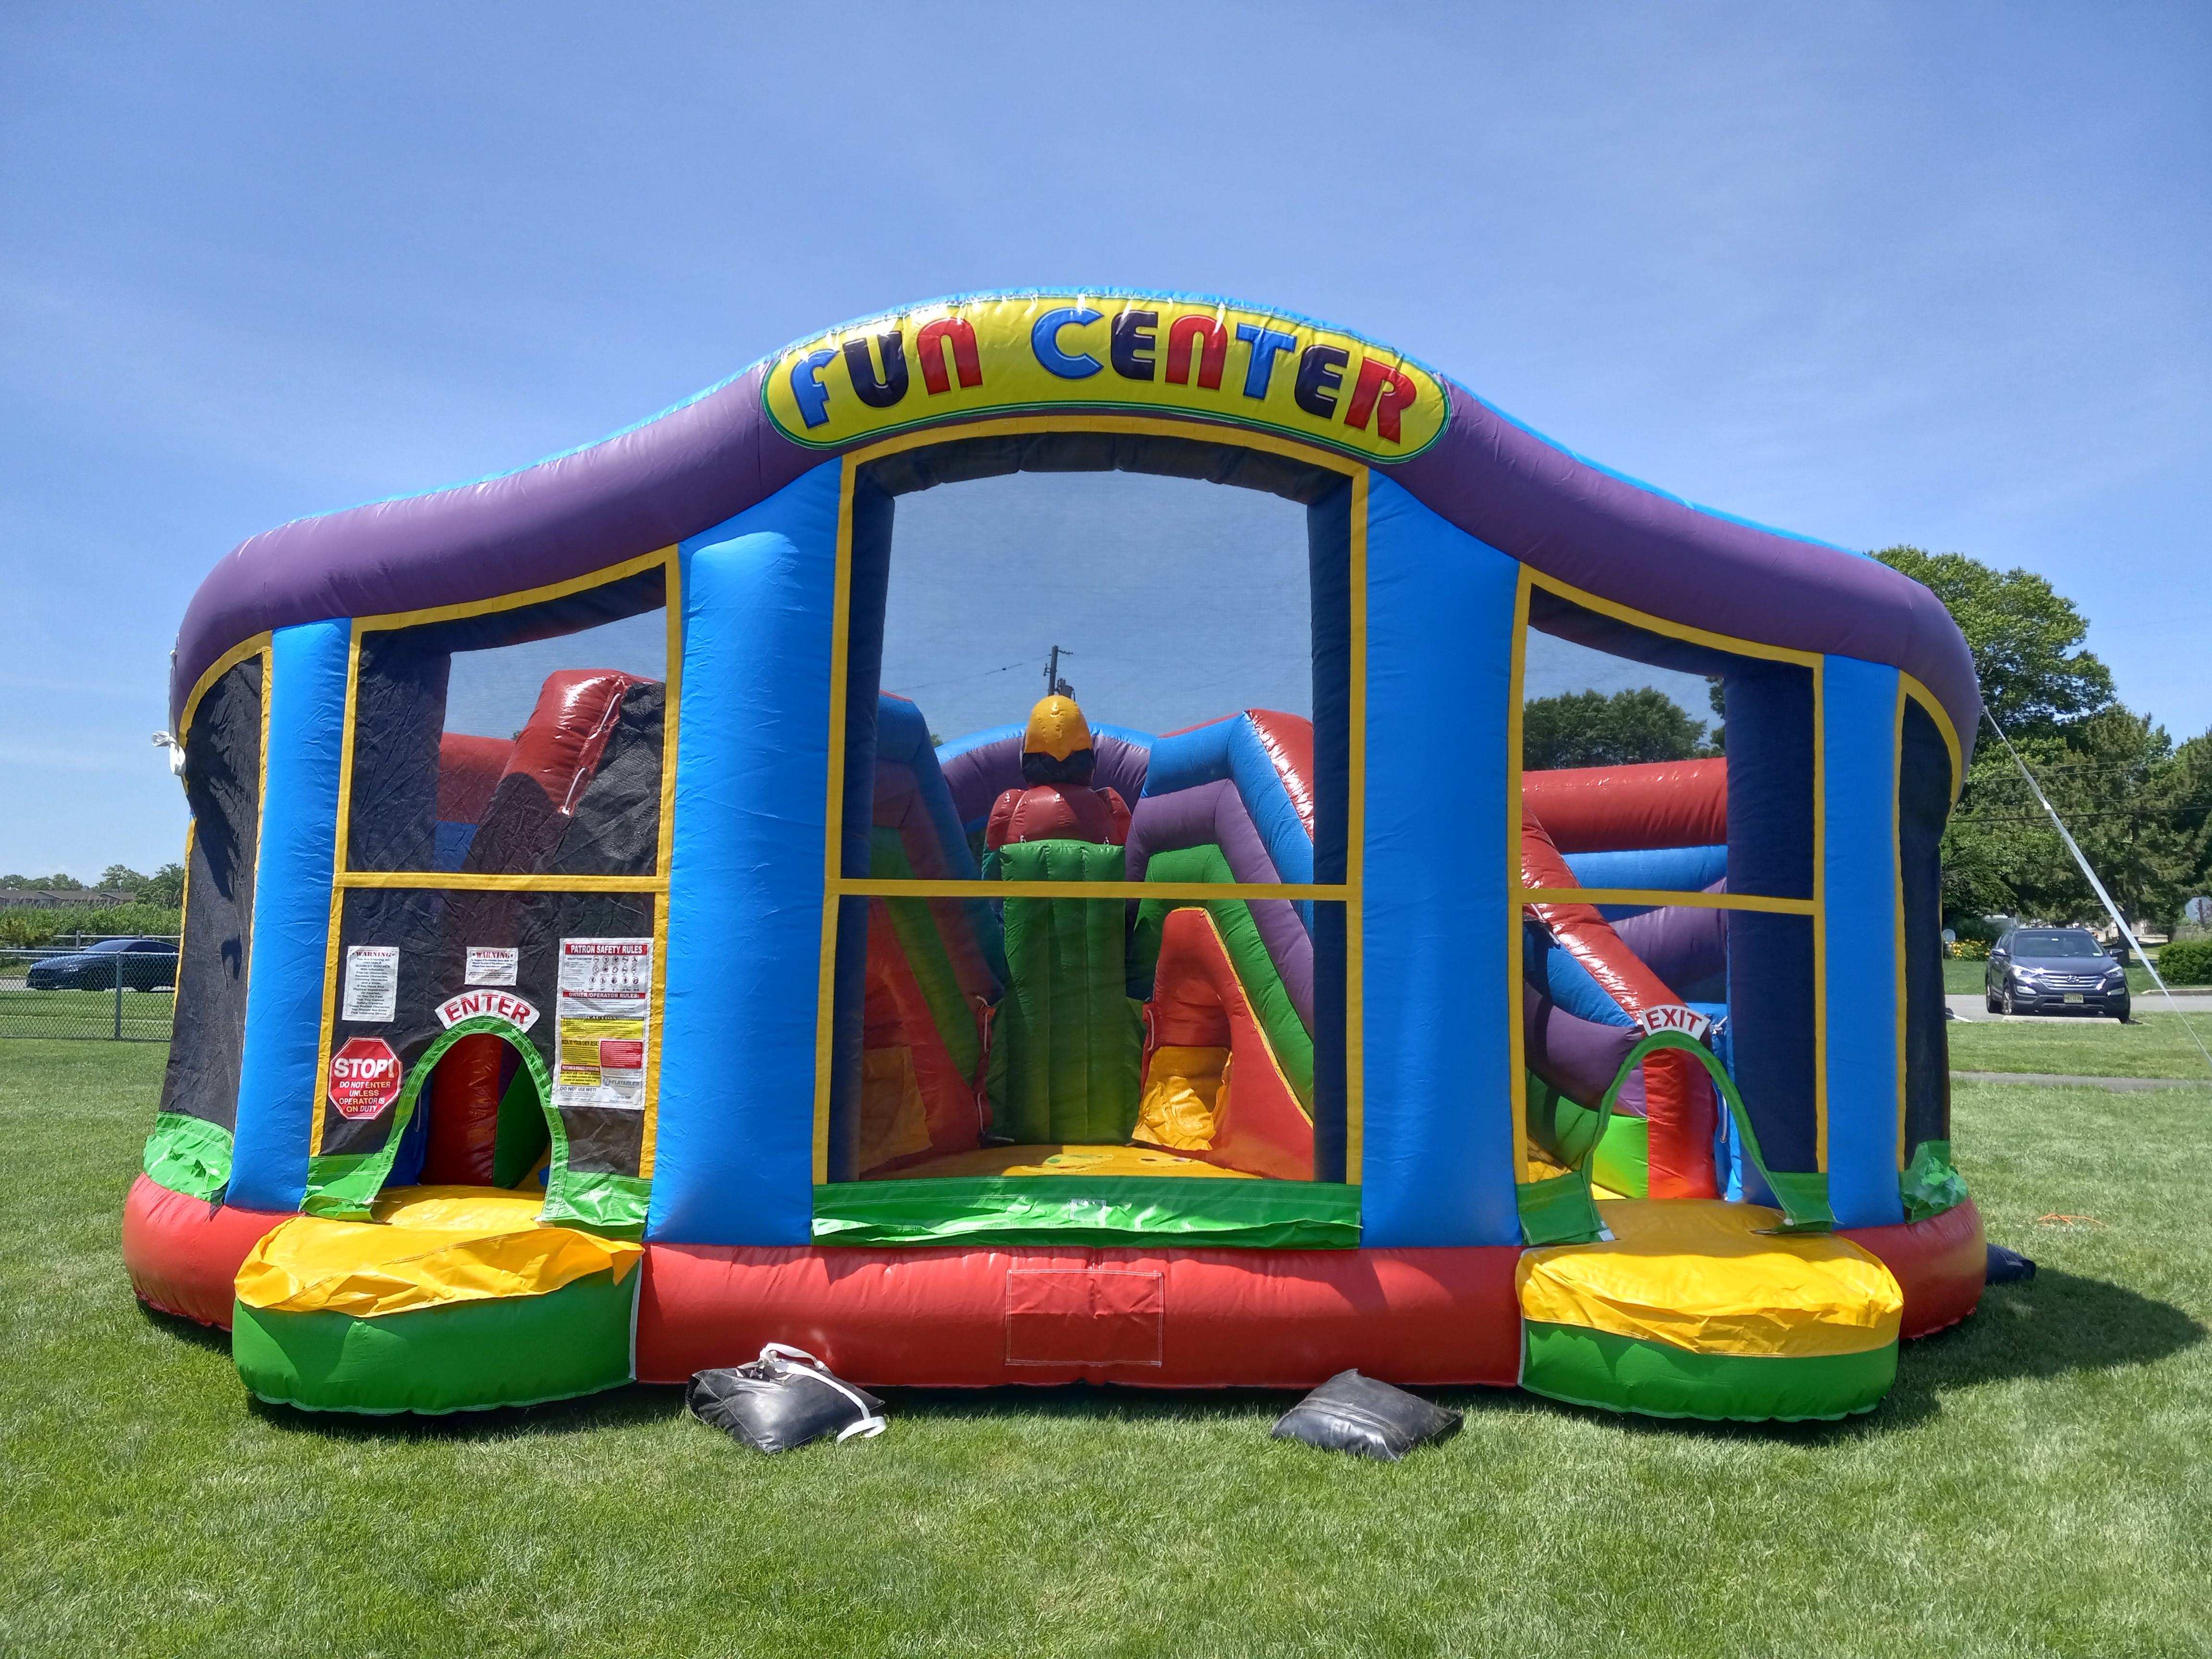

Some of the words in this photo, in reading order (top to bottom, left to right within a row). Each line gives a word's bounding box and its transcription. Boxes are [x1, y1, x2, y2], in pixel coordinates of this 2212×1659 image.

[788, 316, 983, 430] FUN
[1030, 305, 1417, 445] CENTER
[571, 945, 595, 953] PATRON
[596, 945, 620, 953] SAFETY
[444, 993, 530, 1024] ENTER
[1646, 1008, 1703, 1032] EXIT
[334, 1057, 394, 1079] STOP!
